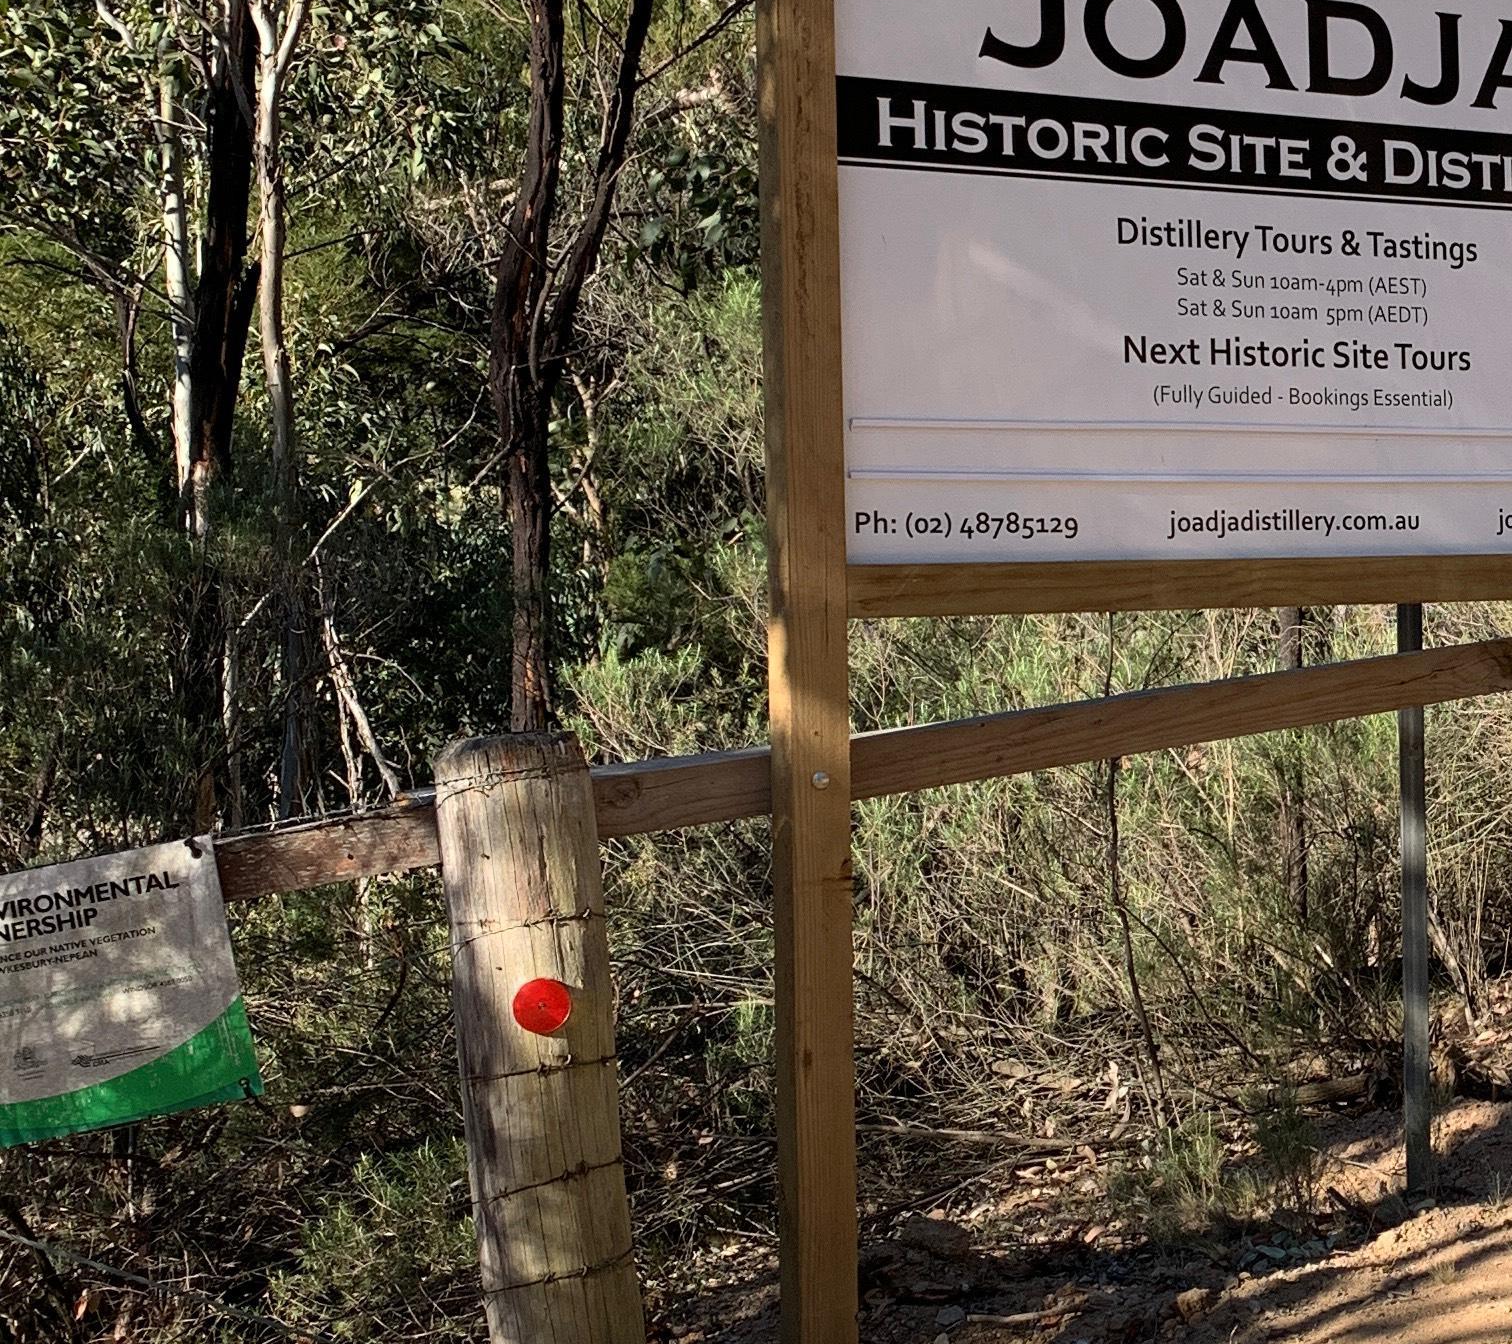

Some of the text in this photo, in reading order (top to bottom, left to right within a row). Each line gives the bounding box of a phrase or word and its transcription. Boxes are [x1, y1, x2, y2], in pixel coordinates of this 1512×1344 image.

[877, 97, 1171, 168] HISTORIC
[1188, 123, 1311, 180] SITE
[1326, 135, 1368, 182] &
[1117, 216, 1478, 270] Distillery Tours & Tastings
[1177, 267, 1427, 298] Sat & Sun 10am-4pm (AEST)
[1177, 297, 1208, 317] Sat
[1212, 299, 1226, 317] &
[1231, 299, 1265, 319] Sun
[1368, 305, 1428, 327] (AEDT)
[1124, 335, 1471, 371] Next Historic Site Tours
[1153, 384, 1204, 409] (Fully
[1208, 385, 1272, 405] Guided
[1289, 386, 1369, 412] Bookings
[1373, 388, 1453, 410] Essential)
[855, 510, 1079, 540] Ph: (02) 48785129
[1167, 508, 1420, 540] joadjadistillery.com.au
[24, 947, 47, 959] OUR
[49, 939, 87, 954] NATIVE
[89, 926, 156, 946] VEGETATION
